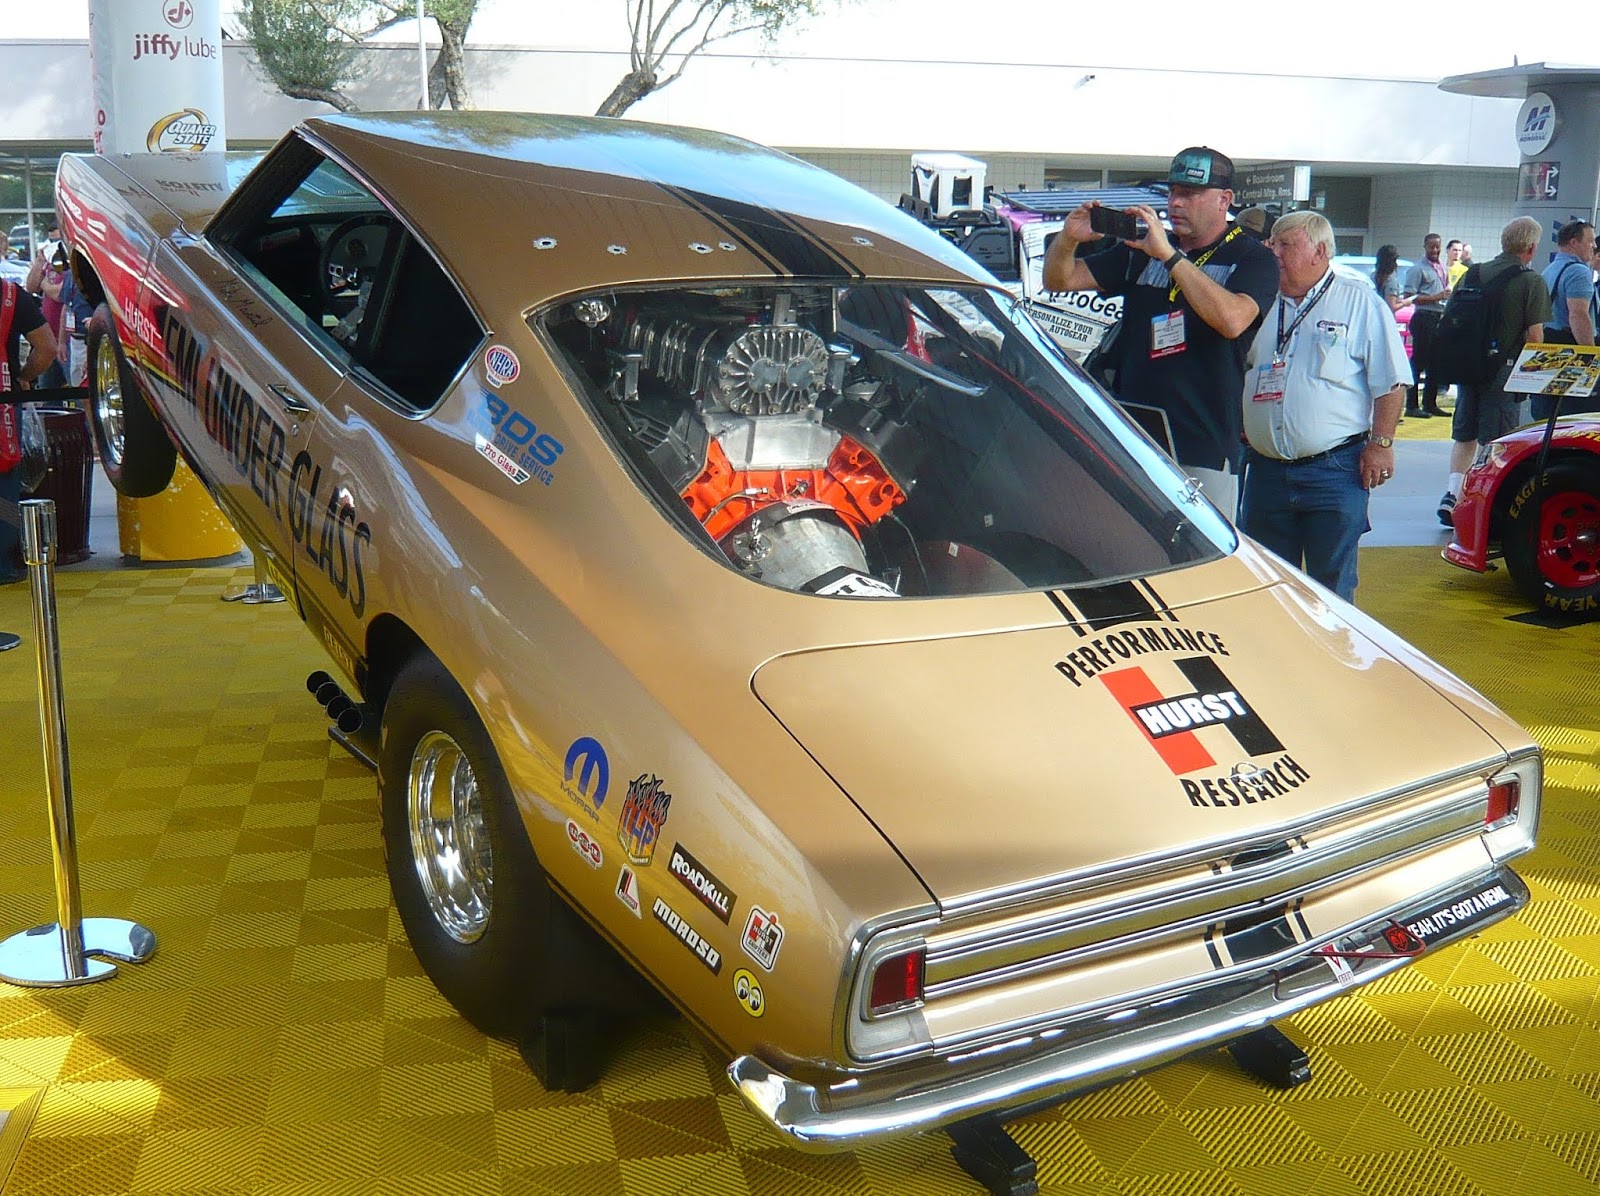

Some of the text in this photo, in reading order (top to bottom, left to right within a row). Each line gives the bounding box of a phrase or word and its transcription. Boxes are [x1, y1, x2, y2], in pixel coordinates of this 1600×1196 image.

[133, 33, 217, 61] jiffy lube
[167, 120, 217, 136] QUAKER
[173, 133, 212, 145] STATE
[1242, 188, 1263, 199] Central
[1252, 173, 1285, 184] Boardroom
[123, 297, 163, 347] HURST
[1027, 308, 1095, 336] ERSONALIZE YOUR
[1048, 324, 1089, 343] AUTOGEAR
[490, 351, 515, 378] NHRA
[484, 443, 518, 477] Pro Glass
[494, 433, 554, 487] DRIVE SERVICE
[287, 449, 372, 620] GLASS
[1544, 592, 1599, 613] YEAR
[1054, 627, 1230, 687] PERFORMANCE
[1136, 690, 1247, 735] HURST
[1179, 753, 1311, 808] RESEARCH
[560, 780, 600, 823] MOPAR
[671, 851, 730, 914] ROADKILL
[1431, 908, 1456, 930] IT'S
[1451, 899, 1478, 920] GOT
[1471, 896, 1486, 912] A
[652, 896, 721, 969] MOROSO
[752, 924, 775, 945] HURST
